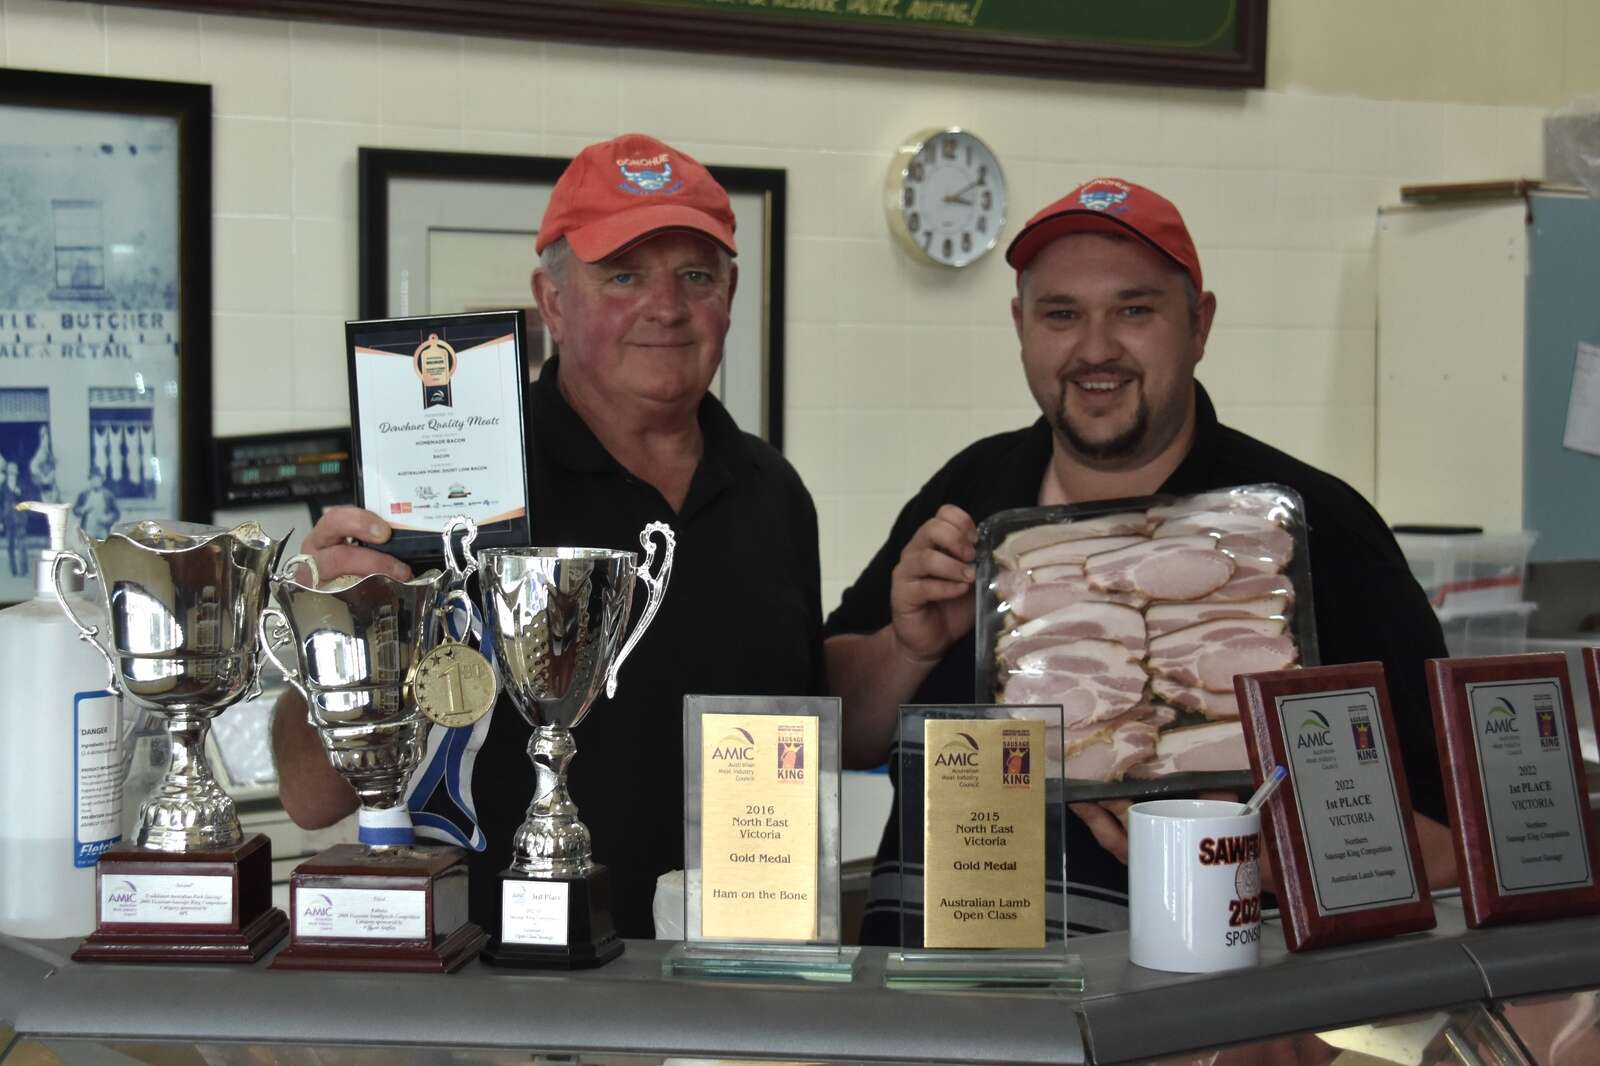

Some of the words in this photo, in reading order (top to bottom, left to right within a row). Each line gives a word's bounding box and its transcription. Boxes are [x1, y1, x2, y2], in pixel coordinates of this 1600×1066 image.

[61, 313, 164, 329] BUTCHER
[61, 344, 132, 359] RETAIL
[427, 418, 464, 431] Quality
[466, 416, 499, 427] Meats
[1485, 718, 1520, 735] AMIC
[1297, 731, 1333, 749] AMIC
[712, 747, 754, 760] AMIC
[1358, 750, 1378, 760] KING
[935, 753, 979, 766] AMIC
[778, 770, 804, 779] KING
[1003, 775, 1030, 785] KING
[1335, 779, 1354, 791] 2022
[1509, 784, 1520, 794] 1st
[1521, 781, 1552, 792] PLACE
[1326, 799, 1337, 810] 1st
[1339, 795, 1372, 808] PLACE
[1512, 798, 1555, 810] VICTORIA
[746, 805, 775, 815] 2016
[732, 817, 762, 826] North
[766, 818, 788, 827] East
[970, 812, 1000, 821] 2015
[1329, 813, 1374, 826] VICTORIA
[739, 829, 781, 839] Victoria
[956, 824, 986, 833] North
[990, 824, 1014, 833] East
[964, 837, 1007, 846] Victoria
[729, 853, 755, 862] Gold
[759, 854, 791, 863] Medal
[953, 861, 980, 871] Gold
[984, 861, 1017, 871] Medal
[108, 893, 137, 903] AMIC
[712, 889, 738, 898] Ham
[741, 891, 755, 899] on
[759, 890, 776, 899] the
[779, 890, 808, 900] Bone
[940, 897, 995, 907] Australian
[999, 898, 1031, 908] Lamb
[304, 907, 332, 916] AMIC
[953, 910, 983, 921] Open
[987, 910, 1017, 920] Class
[1229, 896, 1259, 927] 202
